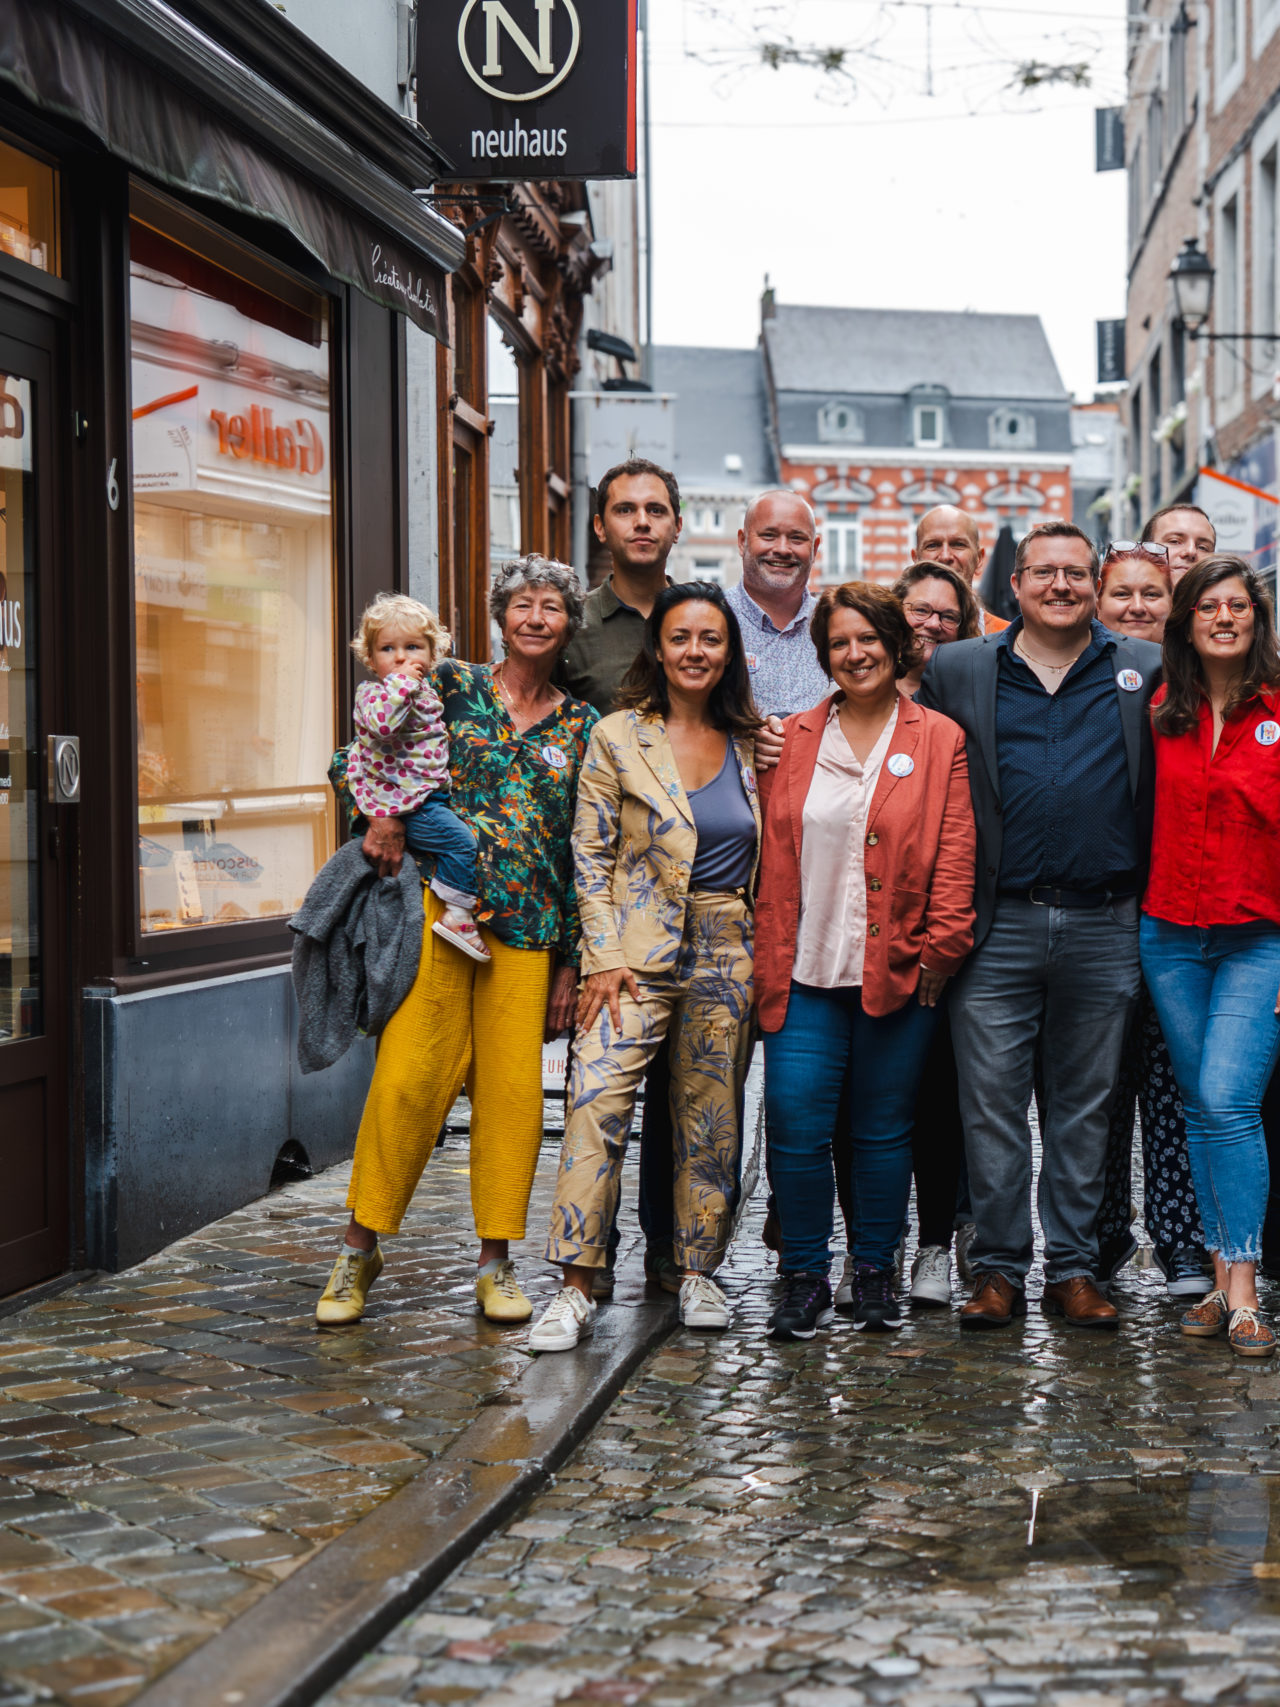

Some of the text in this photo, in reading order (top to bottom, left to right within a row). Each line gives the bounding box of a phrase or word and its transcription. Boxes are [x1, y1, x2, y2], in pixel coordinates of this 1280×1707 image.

[482, 0, 555, 77] N
[471, 118, 568, 158] neuhaus
[106, 457, 120, 511] 6
